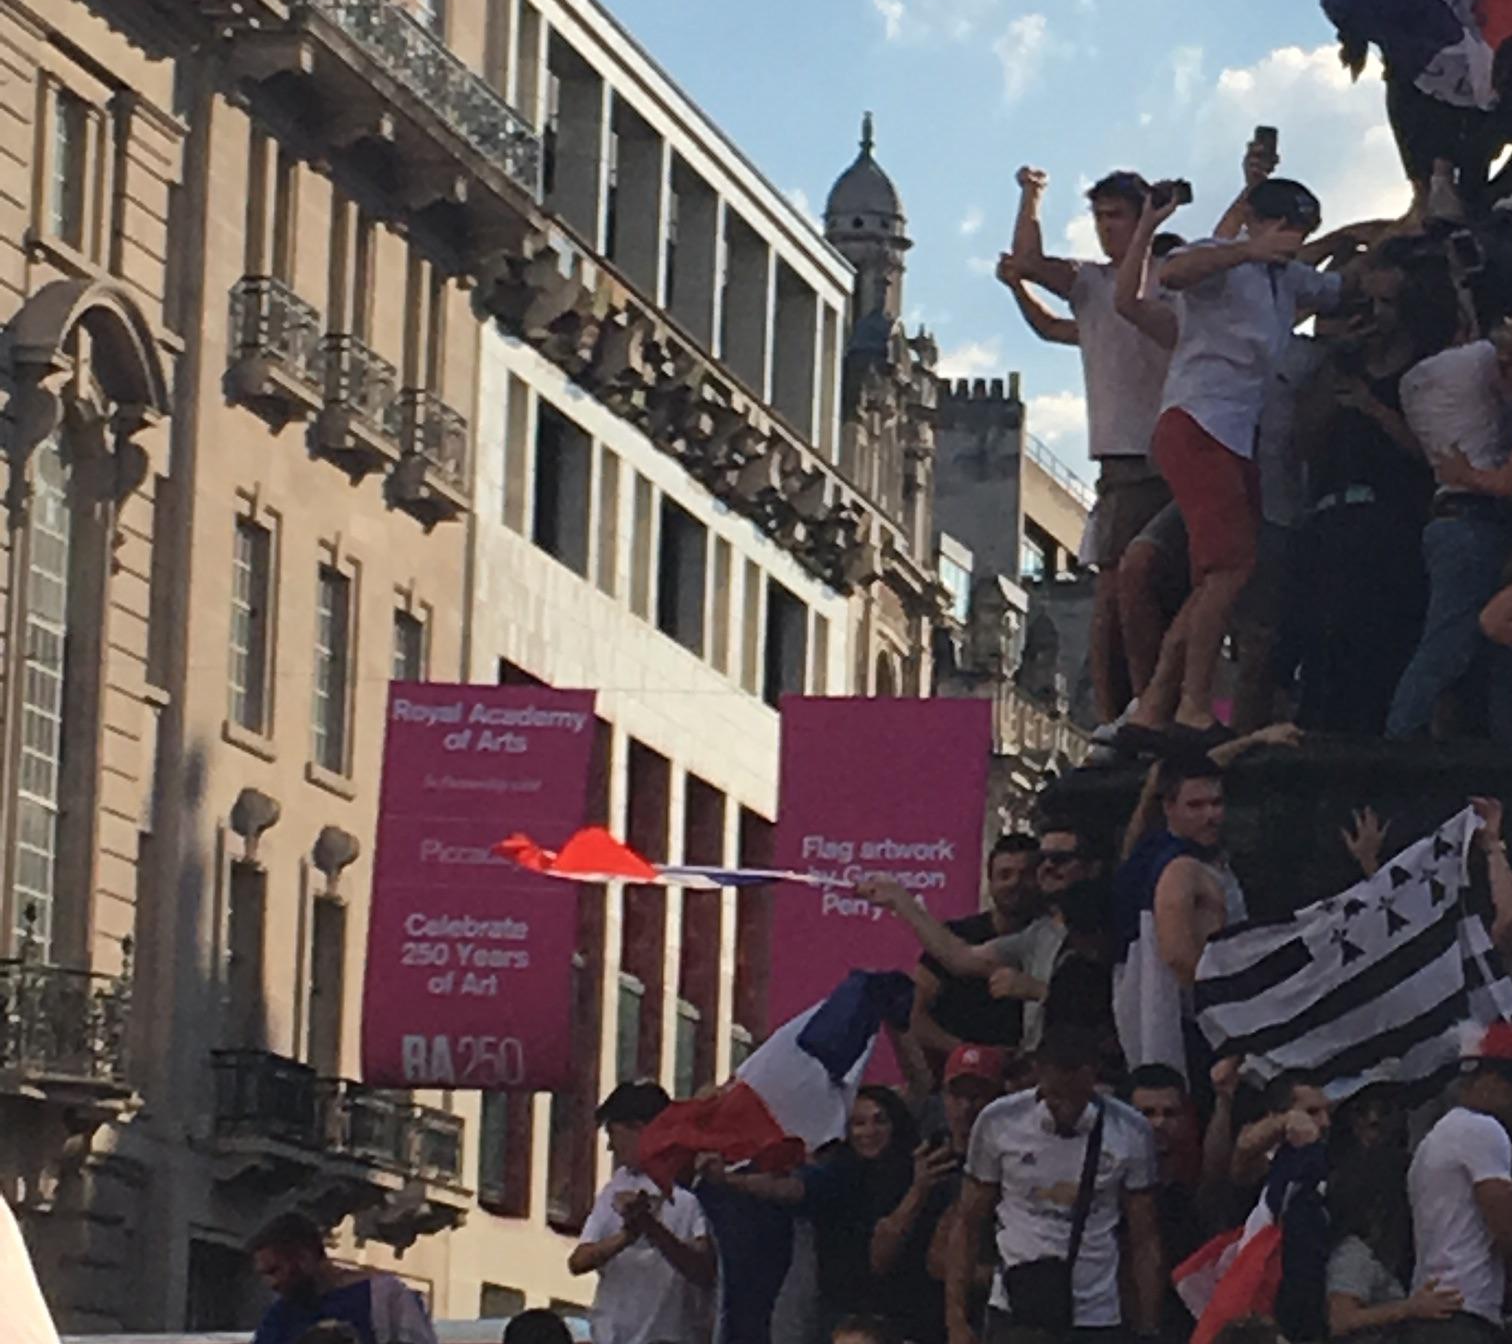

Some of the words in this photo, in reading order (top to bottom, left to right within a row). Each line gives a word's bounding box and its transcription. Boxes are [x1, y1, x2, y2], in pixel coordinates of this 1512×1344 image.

[393, 699, 463, 727] Royal
[469, 703, 586, 732] Academy
[444, 730, 472, 751] of
[476, 730, 527, 753] Arts
[803, 835, 855, 863] Flag
[860, 838, 955, 861] artwork
[405, 913, 528, 940] Celebrate
[401, 942, 449, 966] 250
[456, 943, 530, 968] Years
[428, 971, 455, 994] of
[461, 972, 498, 996] Art
